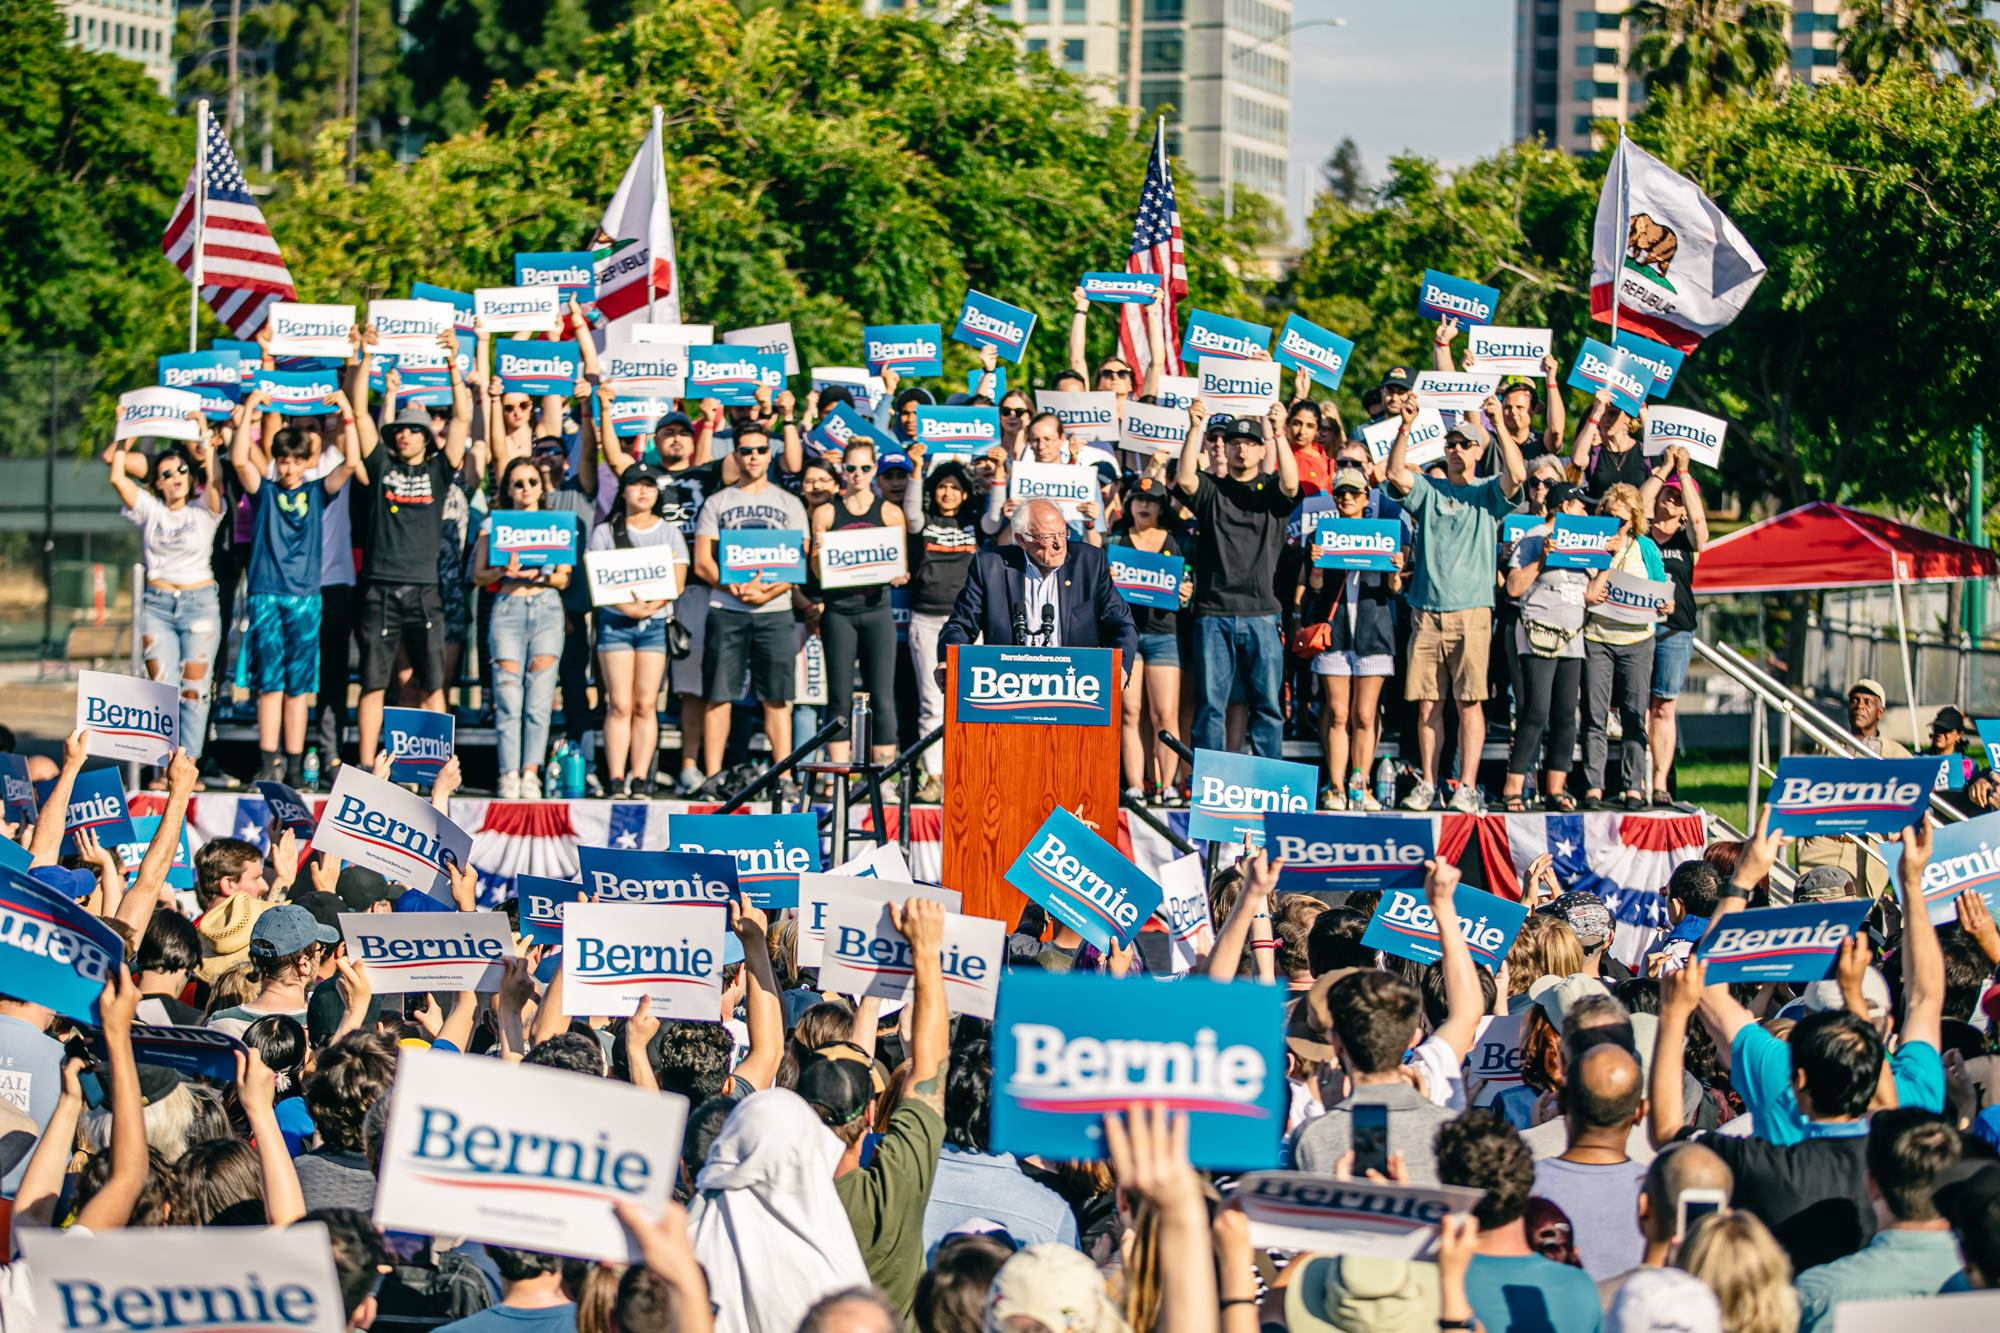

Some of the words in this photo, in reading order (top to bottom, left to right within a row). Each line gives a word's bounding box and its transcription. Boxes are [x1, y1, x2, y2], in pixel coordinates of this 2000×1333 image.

[521, 265, 591, 285] Bernie
[1086, 278, 1155, 292] Bernie
[484, 298, 552, 314] Bernie
[1424, 283, 1490, 320] Bernie
[1620, 278, 1677, 314] REPUBLIC
[277, 318, 347, 337] Bernie
[375, 316, 445, 335] Bernie
[961, 306, 1024, 344] Bernie
[869, 338, 937, 360] Bernie
[1189, 324, 1262, 358] Bernie
[1283, 328, 1343, 371] Bernie
[1476, 339, 1545, 359] Bernie
[164, 364, 237, 387] Bernie
[500, 354, 574, 377] Bernie
[611, 358, 678, 377] Bernie
[692, 358, 758, 379] Bernie
[1579, 351, 1645, 398] Bernie
[260, 379, 333, 400] Bernie
[1203, 373, 1273, 396] Bernie
[1420, 379, 1491, 394] Bernie
[610, 399, 669, 418] ernie
[921, 417, 995, 438] Bernie
[1128, 416, 1188, 441] Berni
[1650, 419, 1718, 447] Bernie
[1019, 477, 1089, 499] Bernie
[720, 504, 789, 529] SYRACUSE
[495, 524, 572, 546] Bernie
[1321, 530, 1396, 551] Bernie
[726, 543, 800, 564] Bernie
[827, 544, 899, 566] Bernie
[597, 564, 667, 585] Bernie
[1112, 560, 1176, 591] Bernie
[807, 642, 823, 697] ernie
[970, 665, 1100, 701] Bernie
[86, 696, 173, 737] Bernie
[391, 729, 452, 758] Bernie
[4, 774, 33, 801] Bernie
[1200, 776, 1308, 813] Bernie
[1778, 776, 1922, 805] Bernie
[334, 794, 458, 870] Bernie
[1276, 835, 1425, 866] Bernie
[591, 870, 730, 902] Bernie
[1033, 832, 1139, 928] Bernie
[1384, 890, 1505, 952] Benie
[357, 931, 504, 960] Bernie
[1709, 919, 1850, 953] Bernie
[576, 936, 714, 978] Bernie
[1010, 1022, 1267, 1102] Bernie
[0, 1076, 27, 1091] AL
[412, 1103, 653, 1194] Bernie
[54, 1271, 317, 1332] Bernie
